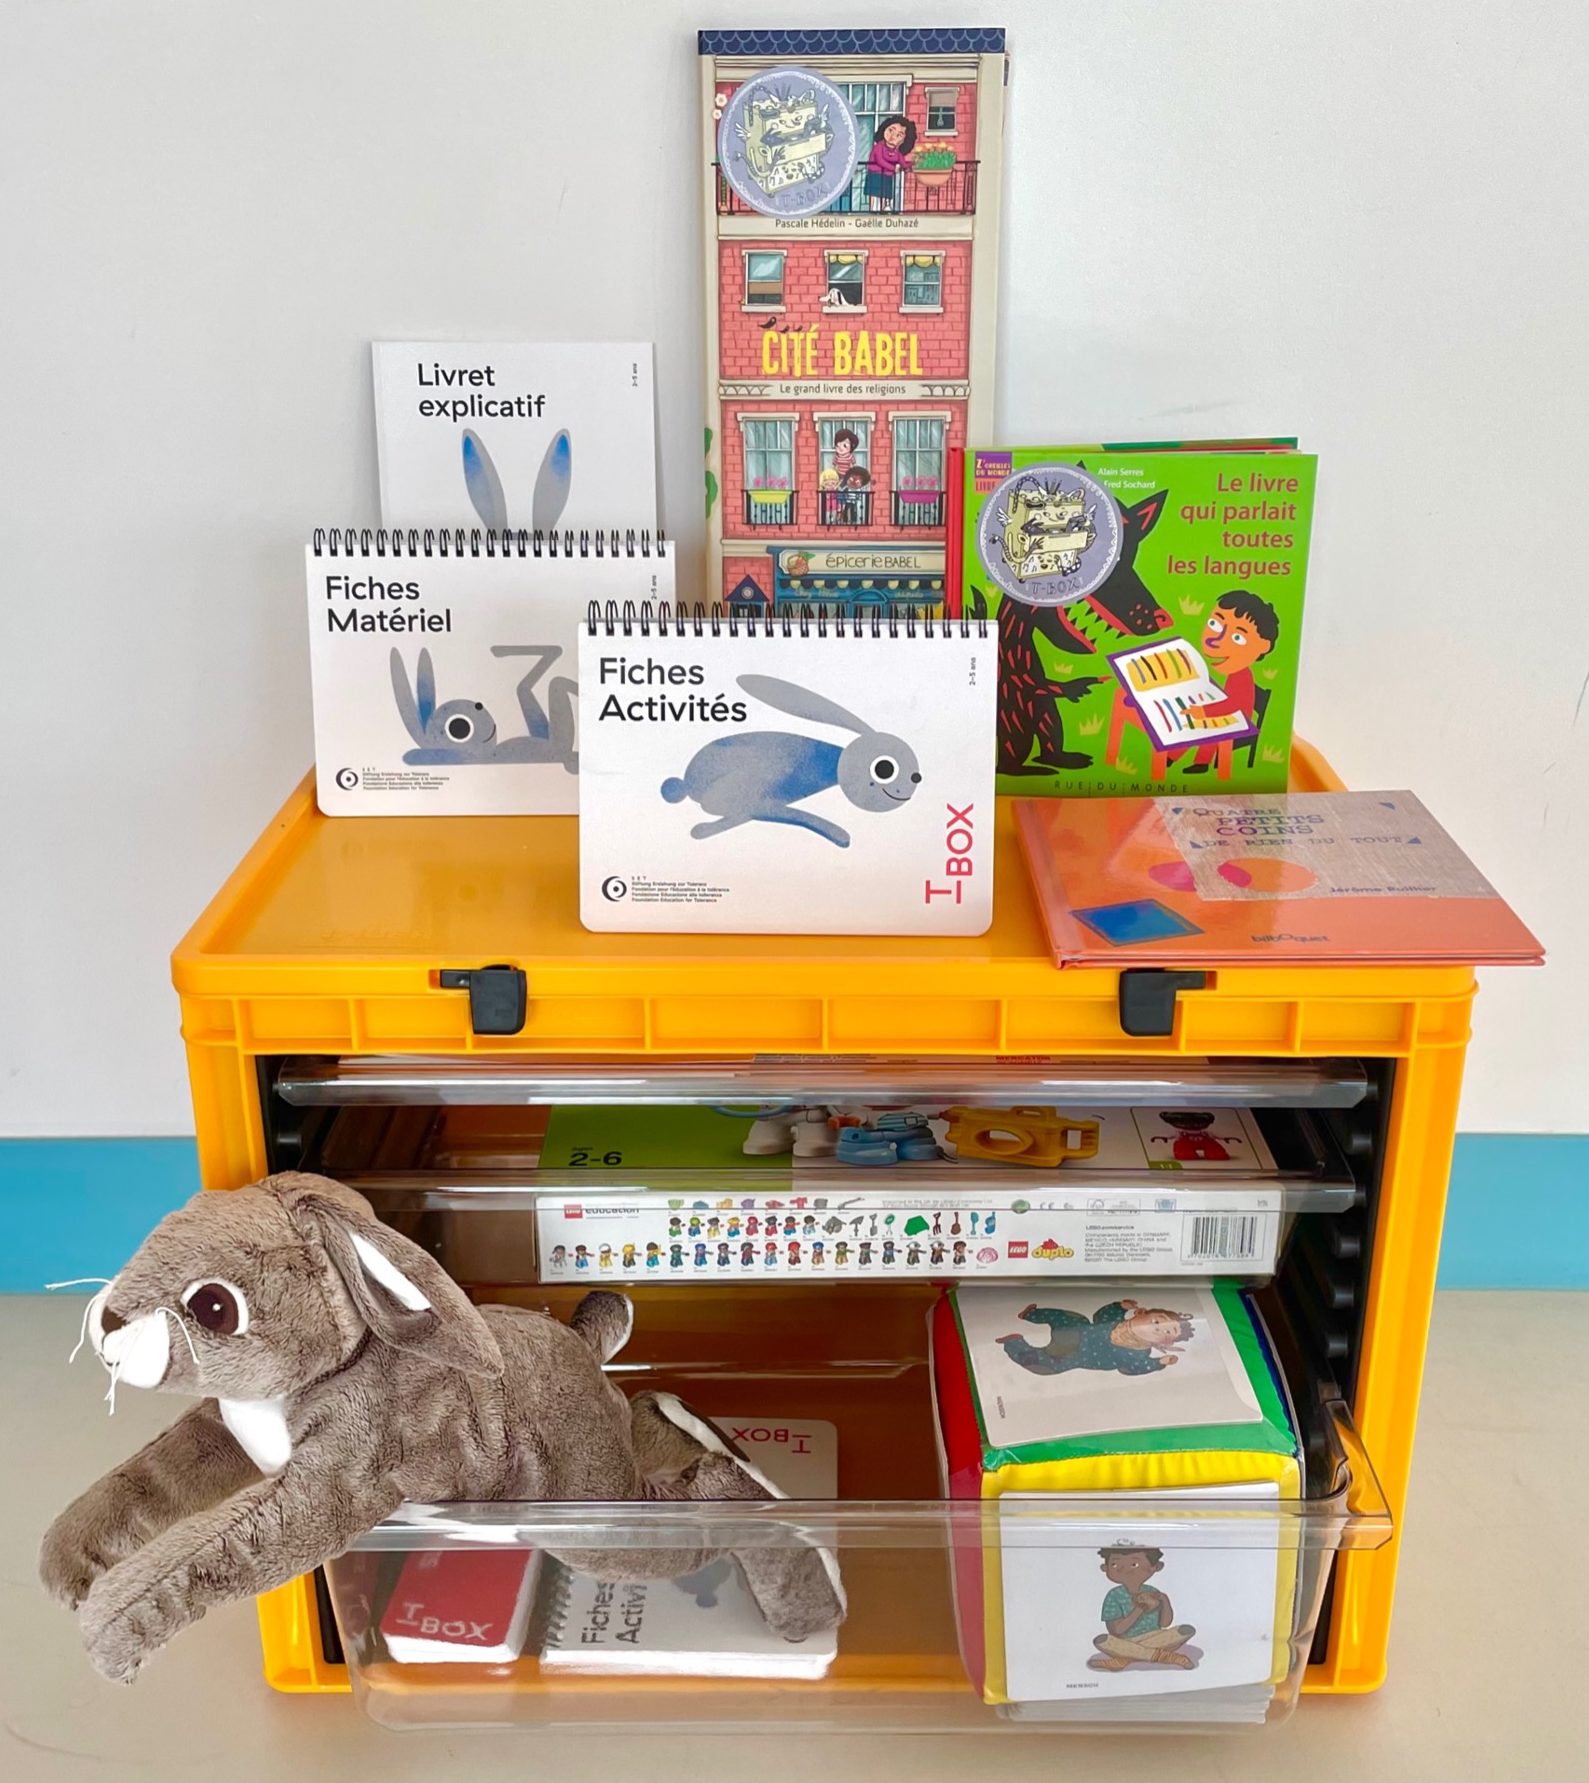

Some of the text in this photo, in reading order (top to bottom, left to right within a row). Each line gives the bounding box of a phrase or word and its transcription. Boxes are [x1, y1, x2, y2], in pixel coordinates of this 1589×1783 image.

[775, 218, 809, 228] Pascale
[811, 218, 846, 228] Hédelin
[855, 218, 883, 228] Gaëlle
[885, 217, 919, 228] Duhazé
[762, 323, 924, 377] CITÉ BABEL
[417, 362, 496, 387] Livret
[779, 383, 907, 396] Le grand livre des religions
[418, 393, 546, 423] explicatif
[1098, 467, 1144, 477] Alain Serres
[1122, 479, 1156, 489] Sochard
[1217, 472, 1299, 494] Le livre
[1180, 500, 1297, 525] qui parlait
[1222, 530, 1294, 549] toutes
[884, 556, 922, 569] BABEL
[1168, 555, 1292, 580] les langues
[325, 574, 420, 601] Fiches
[327, 606, 452, 633] Matériel
[599, 656, 705, 686] Fiches
[598, 692, 748, 723] Activités
[1053, 780, 1190, 794] RUE DU MONDE
[1193, 807, 1282, 816] QUATRE
[1216, 814, 1325, 826] PETITS
[1215, 825, 1315, 837] COINS
[1202, 835, 1403, 848] DE RIEN DU TOUT
[568, 1150, 623, 1167] 2-6
[1009, 1245, 1028, 1255] LEGO
[1031, 1243, 1075, 1261] duplo
